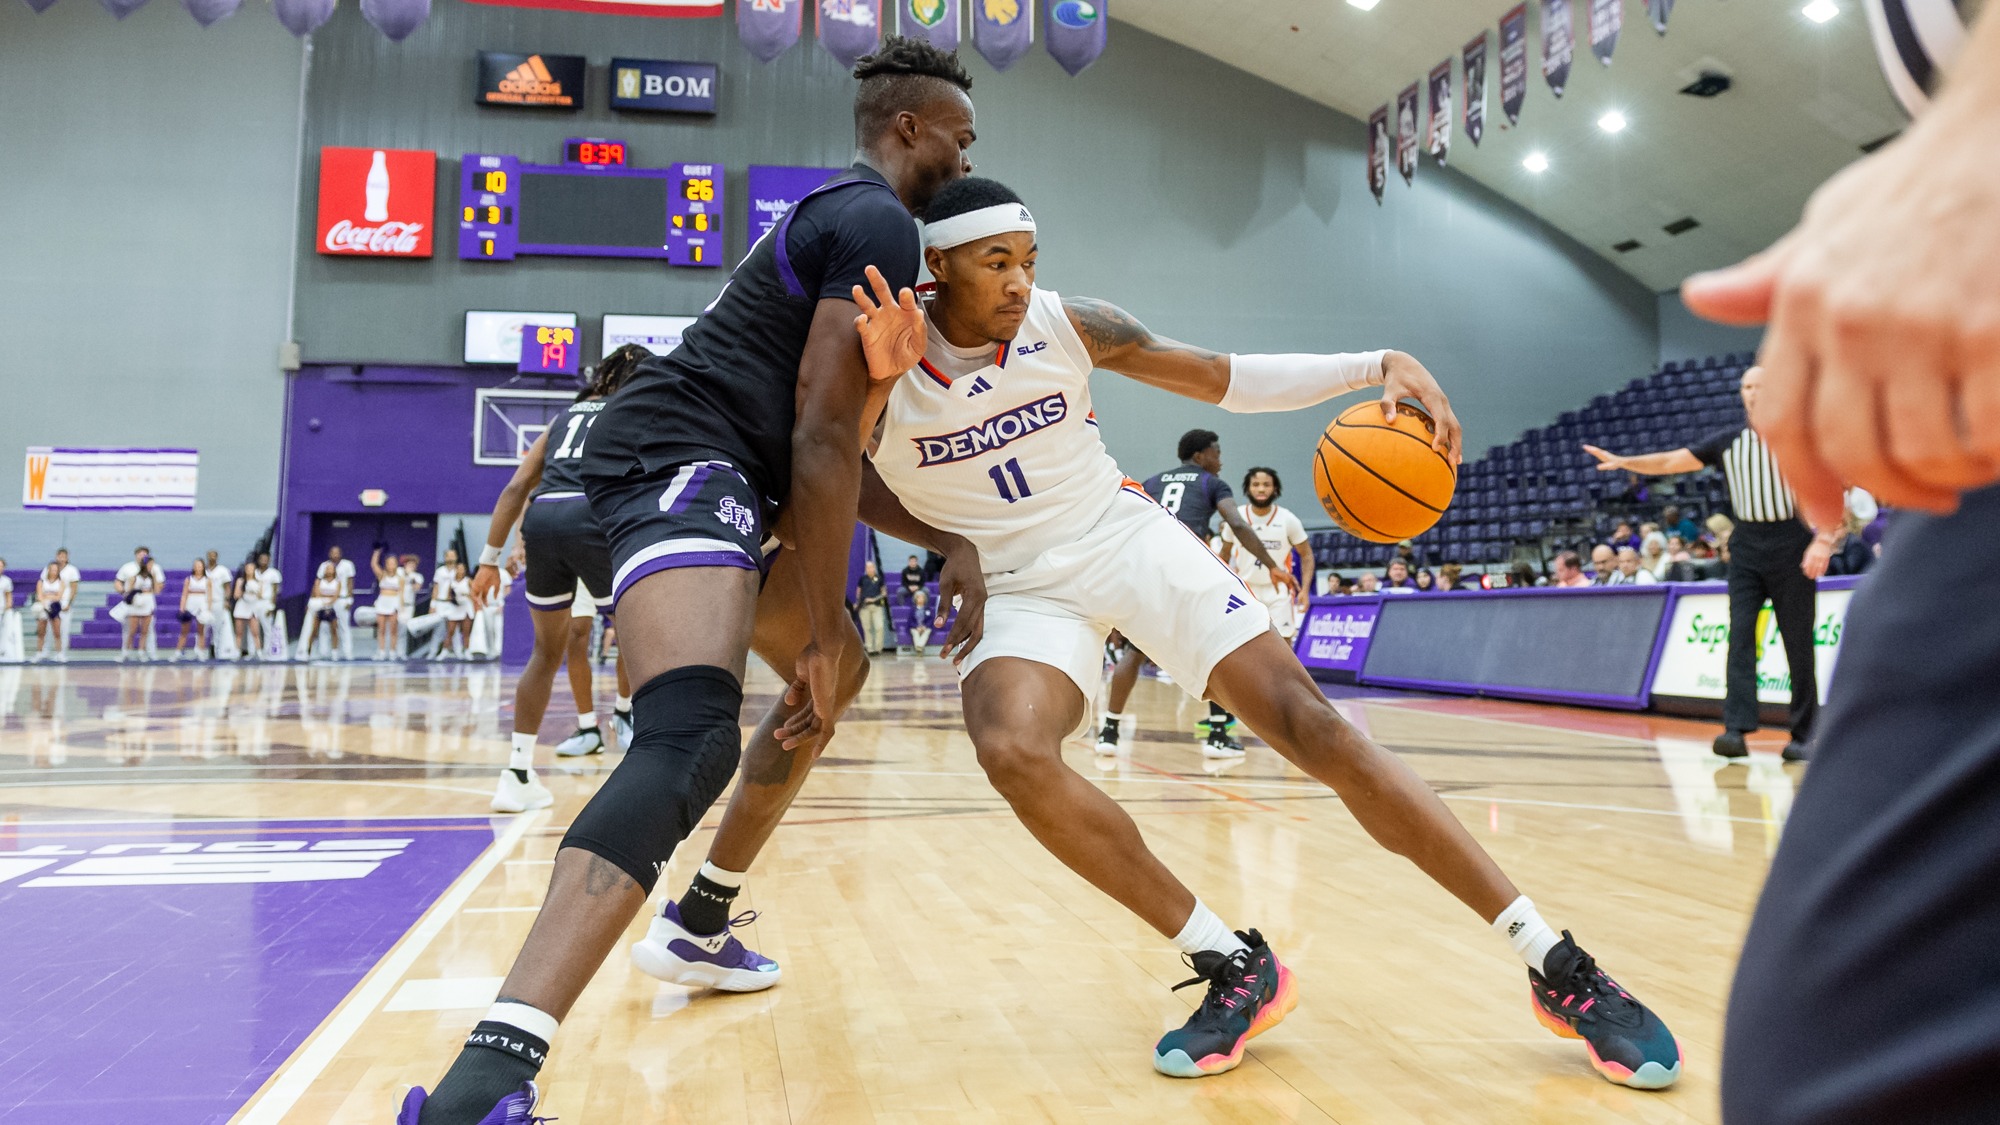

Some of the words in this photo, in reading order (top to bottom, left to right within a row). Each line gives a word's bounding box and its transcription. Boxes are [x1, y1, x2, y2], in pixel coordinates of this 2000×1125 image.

[644, 75, 711, 98] BOM
[580, 143, 625, 165] 8:39
[486, 171, 507, 193] 10
[683, 165, 712, 176] GUEST
[686, 179, 714, 200] 26
[487, 206, 500, 225] 3
[695, 213, 709, 232] 6
[542, 344, 566, 369] 19
[922, 397, 1066, 463] DEMONS
[30, 456, 49, 500] W
[988, 457, 1032, 503] 11
[1161, 473, 1199, 482] CAJUSTE
[1160, 482, 1186, 514] 8
[720, 496, 753, 532] SFA
[1688, 614, 1730, 653] Sup
